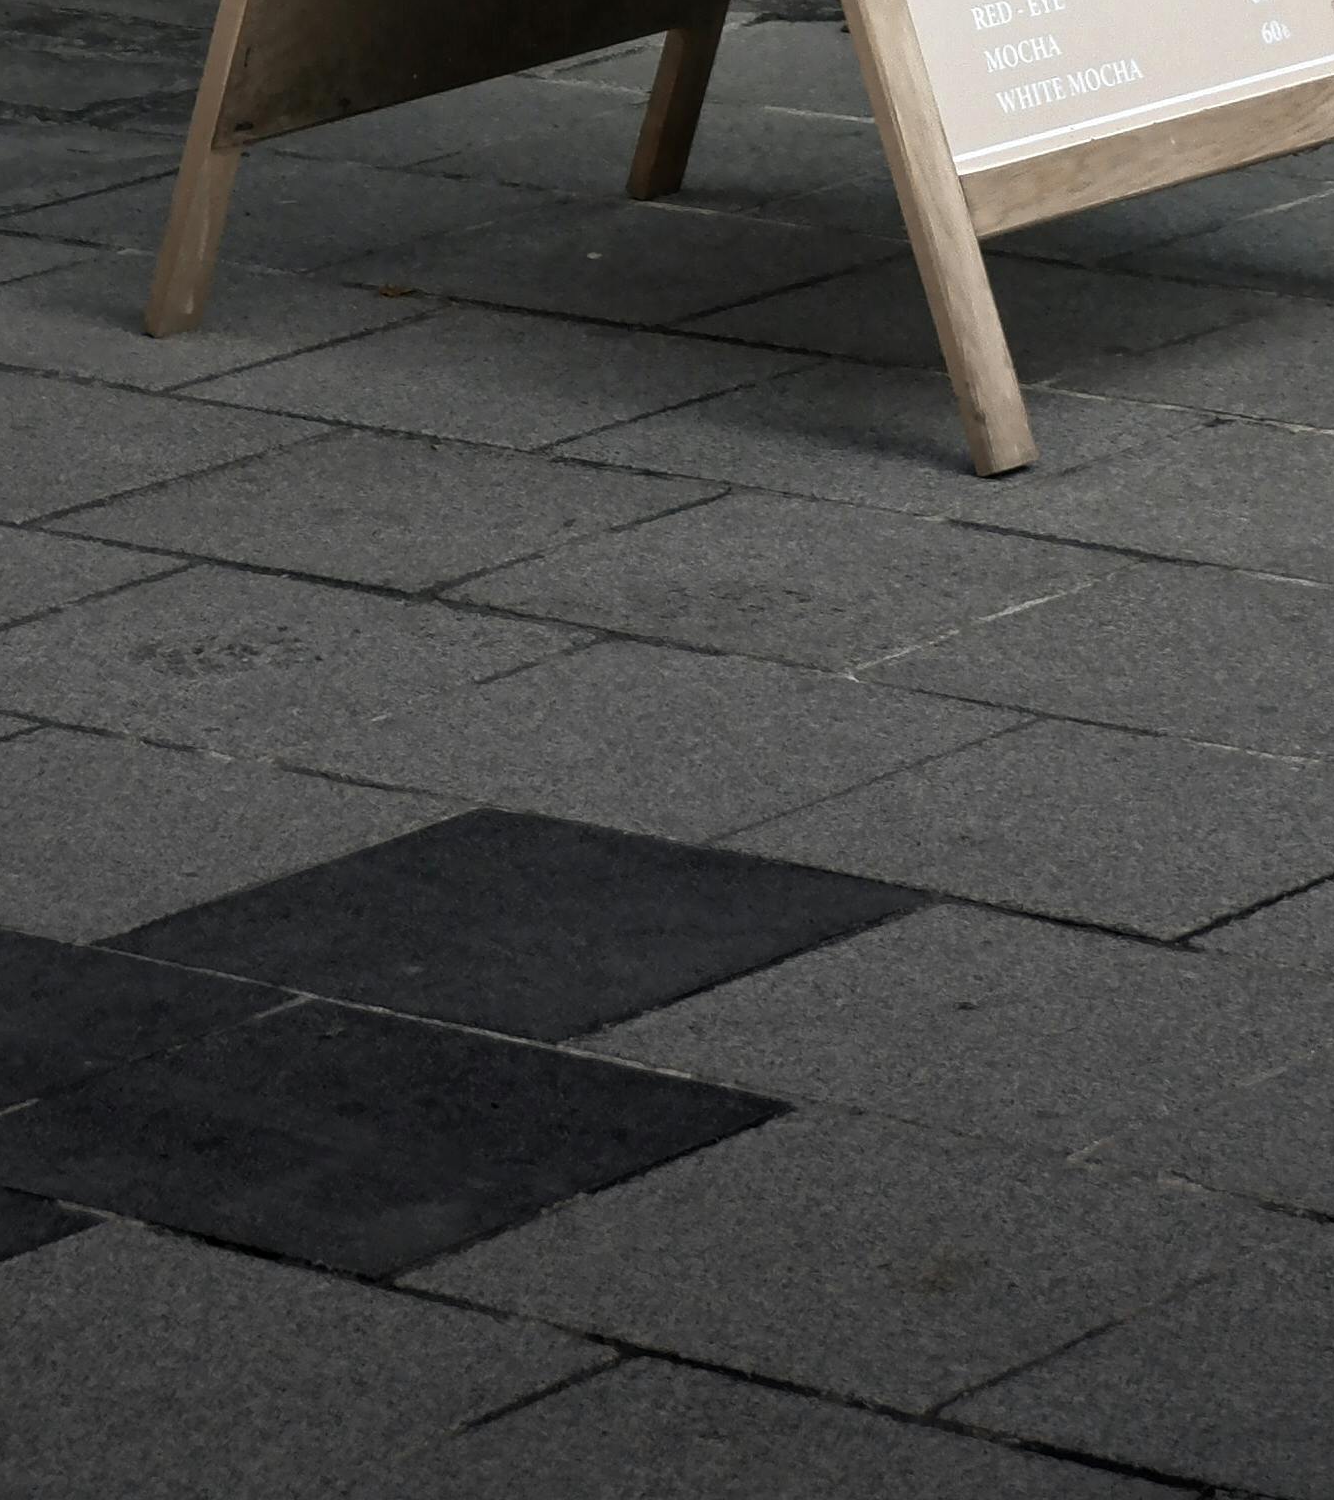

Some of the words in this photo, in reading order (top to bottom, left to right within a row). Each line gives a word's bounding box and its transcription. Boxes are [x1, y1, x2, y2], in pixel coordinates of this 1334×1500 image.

[971, 0, 1013, 31] RED
[984, 33, 1063, 74] MOCHA
[995, 75, 1068, 115] WHITE
[1066, 57, 1144, 99] MOCHA
